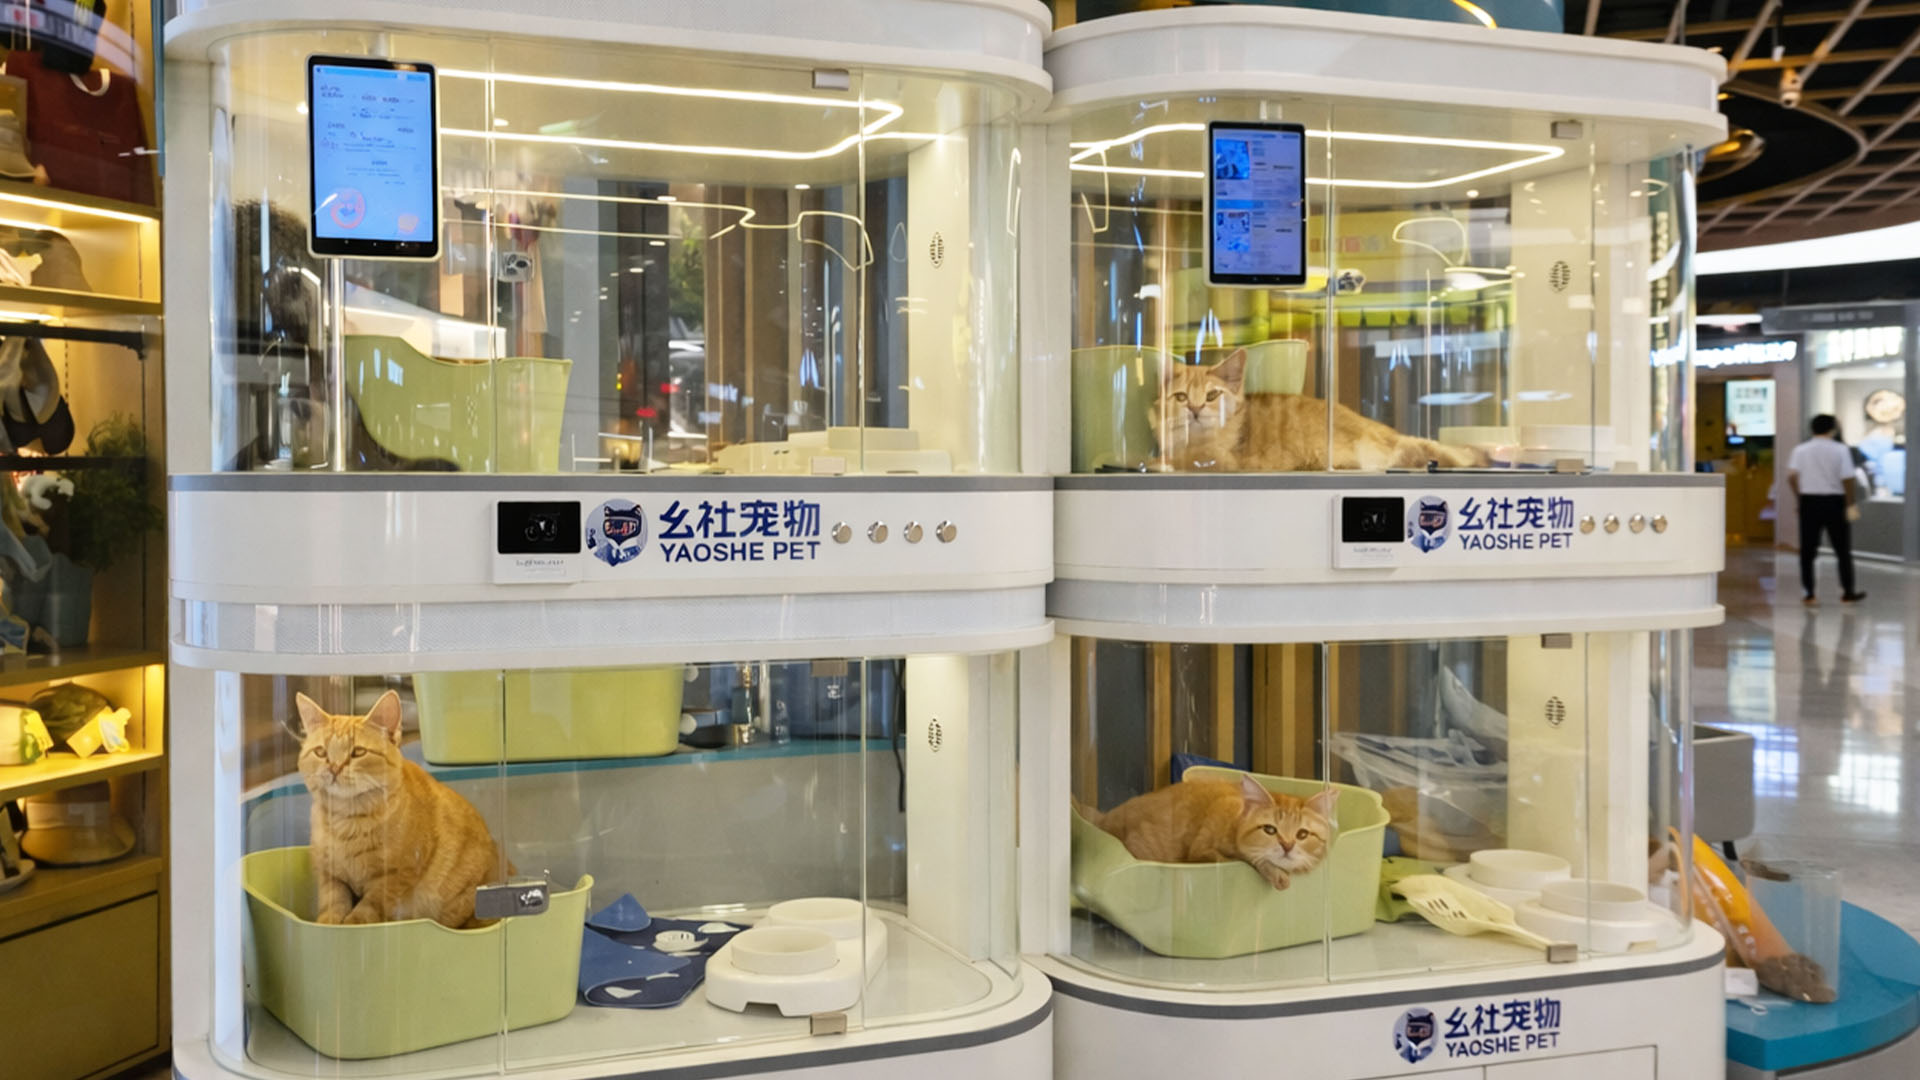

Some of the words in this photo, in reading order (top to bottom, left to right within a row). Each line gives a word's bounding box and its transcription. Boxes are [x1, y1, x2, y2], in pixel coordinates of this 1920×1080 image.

[661, 542, 764, 562] YAOSHE
[773, 541, 821, 561] PET
[1459, 533, 1534, 550] YAOSHE
[1539, 532, 1573, 549] PET
[1446, 1036, 1520, 1058] YAOSHE
[1525, 1032, 1561, 1050] PET
